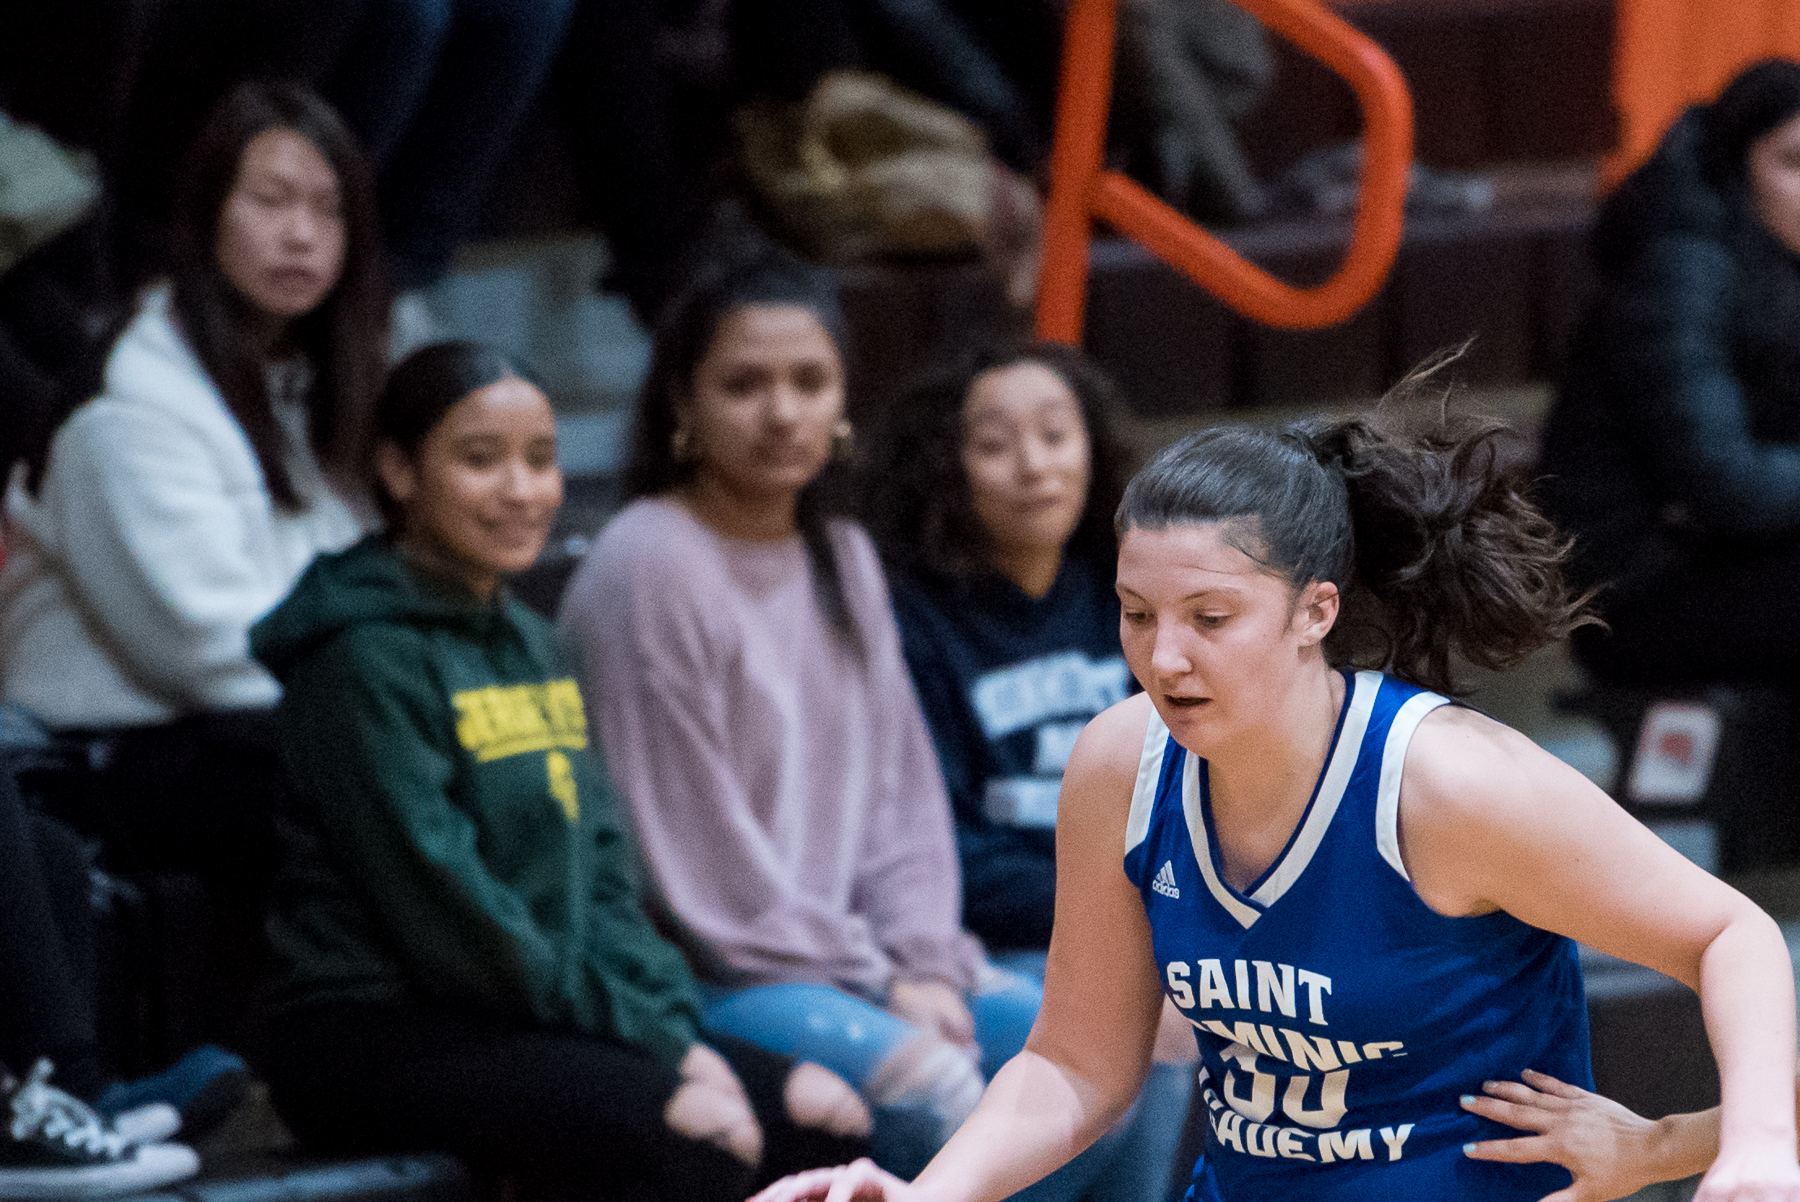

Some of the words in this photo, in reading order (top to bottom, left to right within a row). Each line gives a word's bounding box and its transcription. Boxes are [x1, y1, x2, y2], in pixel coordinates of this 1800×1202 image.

[1152, 879, 1180, 899] adidas
[1166, 958, 1333, 1026] SAINT
[1199, 1066, 1415, 1163] ADEMY
